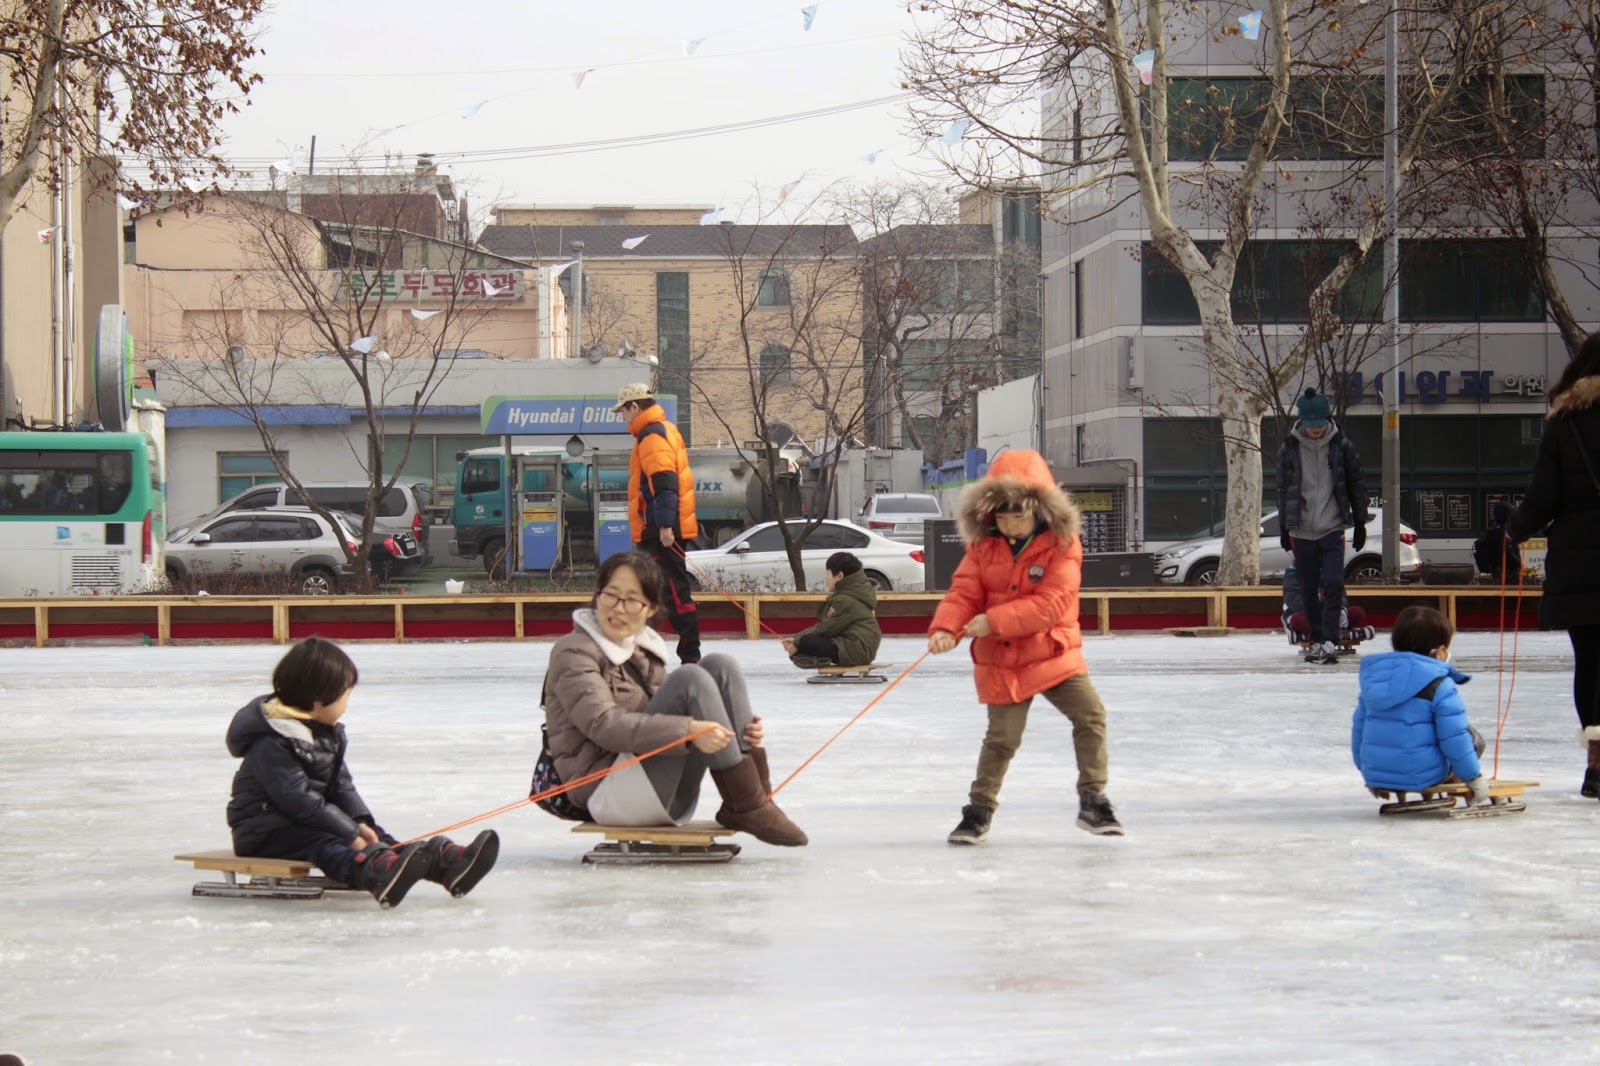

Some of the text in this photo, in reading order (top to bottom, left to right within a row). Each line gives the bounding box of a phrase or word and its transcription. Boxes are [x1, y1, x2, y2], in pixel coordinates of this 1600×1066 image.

[1503, 374, 1545, 396] 의원
[508, 406, 628, 427] Hyundai Oilba
